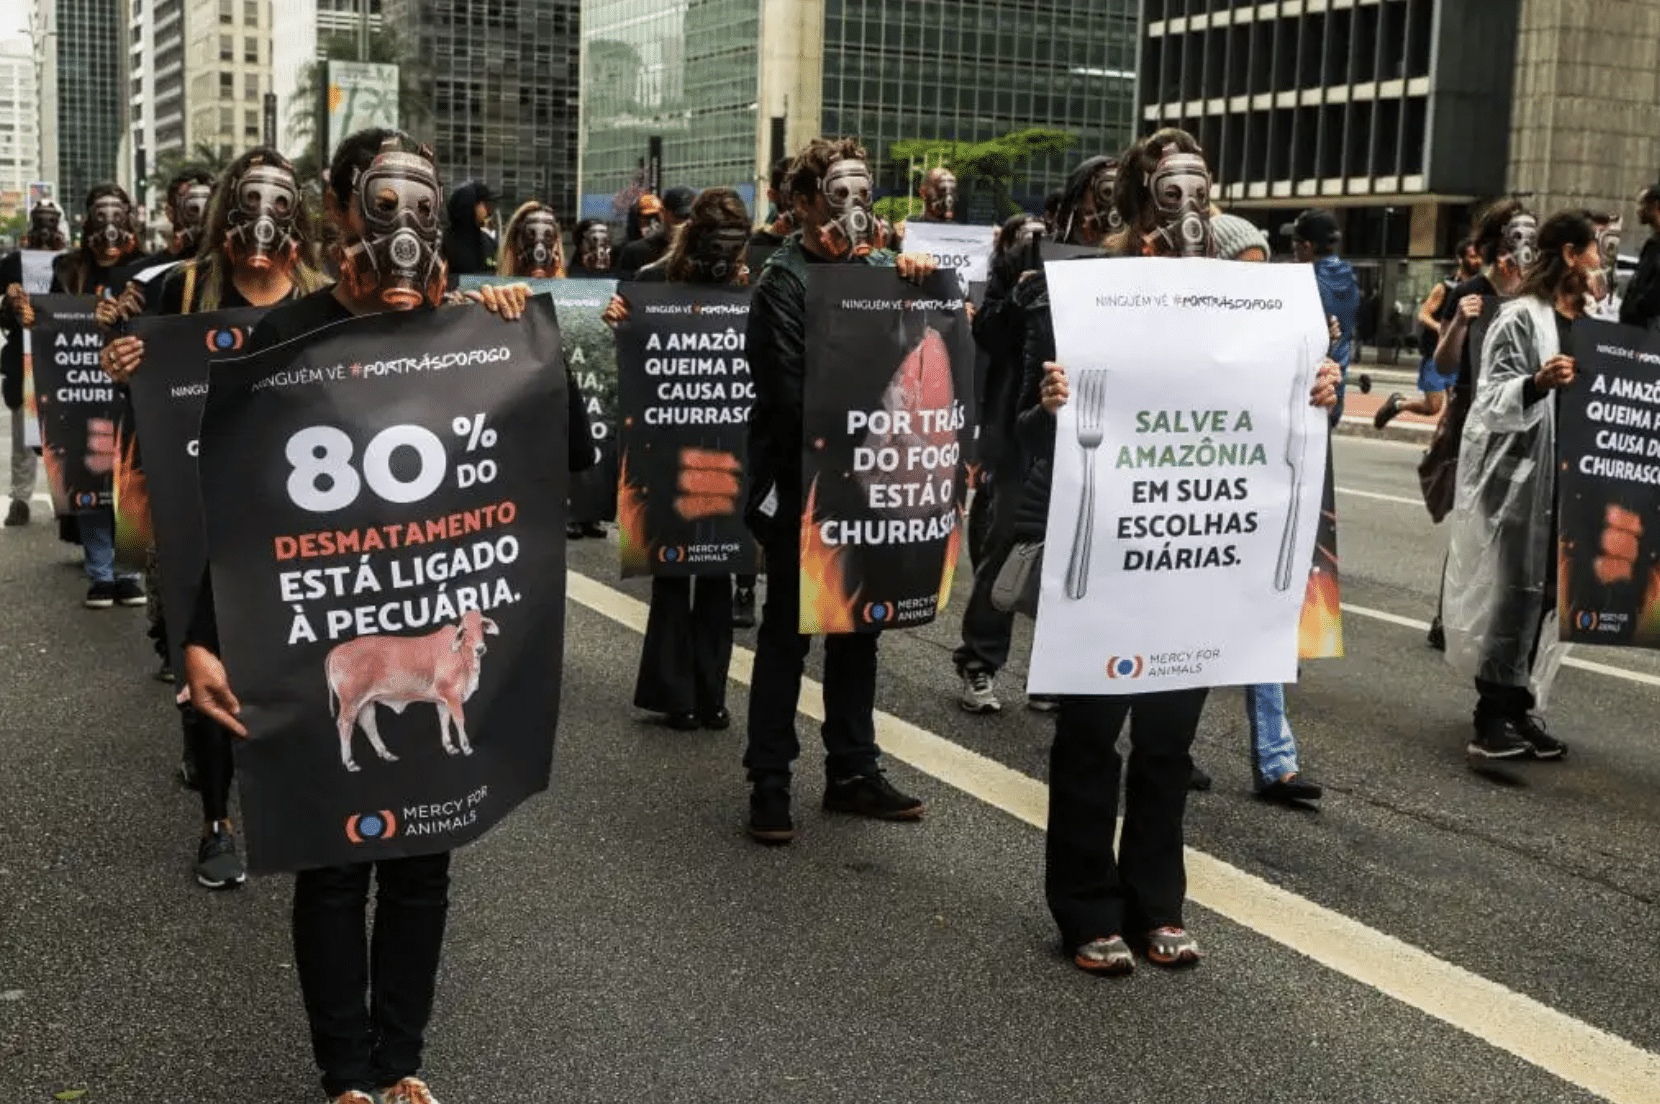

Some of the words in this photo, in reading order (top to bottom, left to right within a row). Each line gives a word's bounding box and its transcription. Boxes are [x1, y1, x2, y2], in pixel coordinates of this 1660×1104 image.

[932, 254, 971, 267] ODOS
[1096, 293, 1151, 308] NINGUÉM
[54, 332, 69, 347] A
[645, 332, 662, 351] A
[54, 351, 100, 366] QUEI
[325, 363, 347, 381] VÊ
[644, 357, 728, 376] QUEIMA
[171, 383, 209, 398] NINGU
[656, 381, 727, 400] CAUSA
[1589, 373, 1607, 395] A
[846, 410, 913, 435] POR
[917, 399, 966, 433] TRÁS
[1135, 410, 1229, 434] SALVE
[1233, 410, 1254, 432] A
[1585, 400, 1651, 431] QUEIMA
[1115, 436, 1268, 470] AMAZÔNIA
[1595, 429, 1646, 457] CAUSA
[853, 447, 900, 473] DO
[906, 442, 961, 472] FOGO
[456, 459, 498, 489] DO
[868, 474, 936, 509] ESTÁ
[940, 478, 953, 503] O
[1131, 480, 1169, 504] EM
[1176, 477, 1249, 502] SUAS
[273, 500, 518, 562] DESMATAMENTO
[1116, 511, 1259, 540] ESCOLHAS
[279, 554, 383, 602] ESTÁ
[390, 534, 521, 590] LIGADO
[1122, 541, 1242, 572] DIÁRIAS.
[286, 604, 319, 645] À
[326, 576, 523, 641] PECUÁRIA.
[1148, 662, 1203, 677] ANIMALS
[1149, 651, 1194, 664] MERCY
[1196, 649, 1221, 661] FOR
[403, 798, 464, 821] MERCY
[466, 785, 489, 808] FOR
[404, 809, 478, 836] ANIMALS
